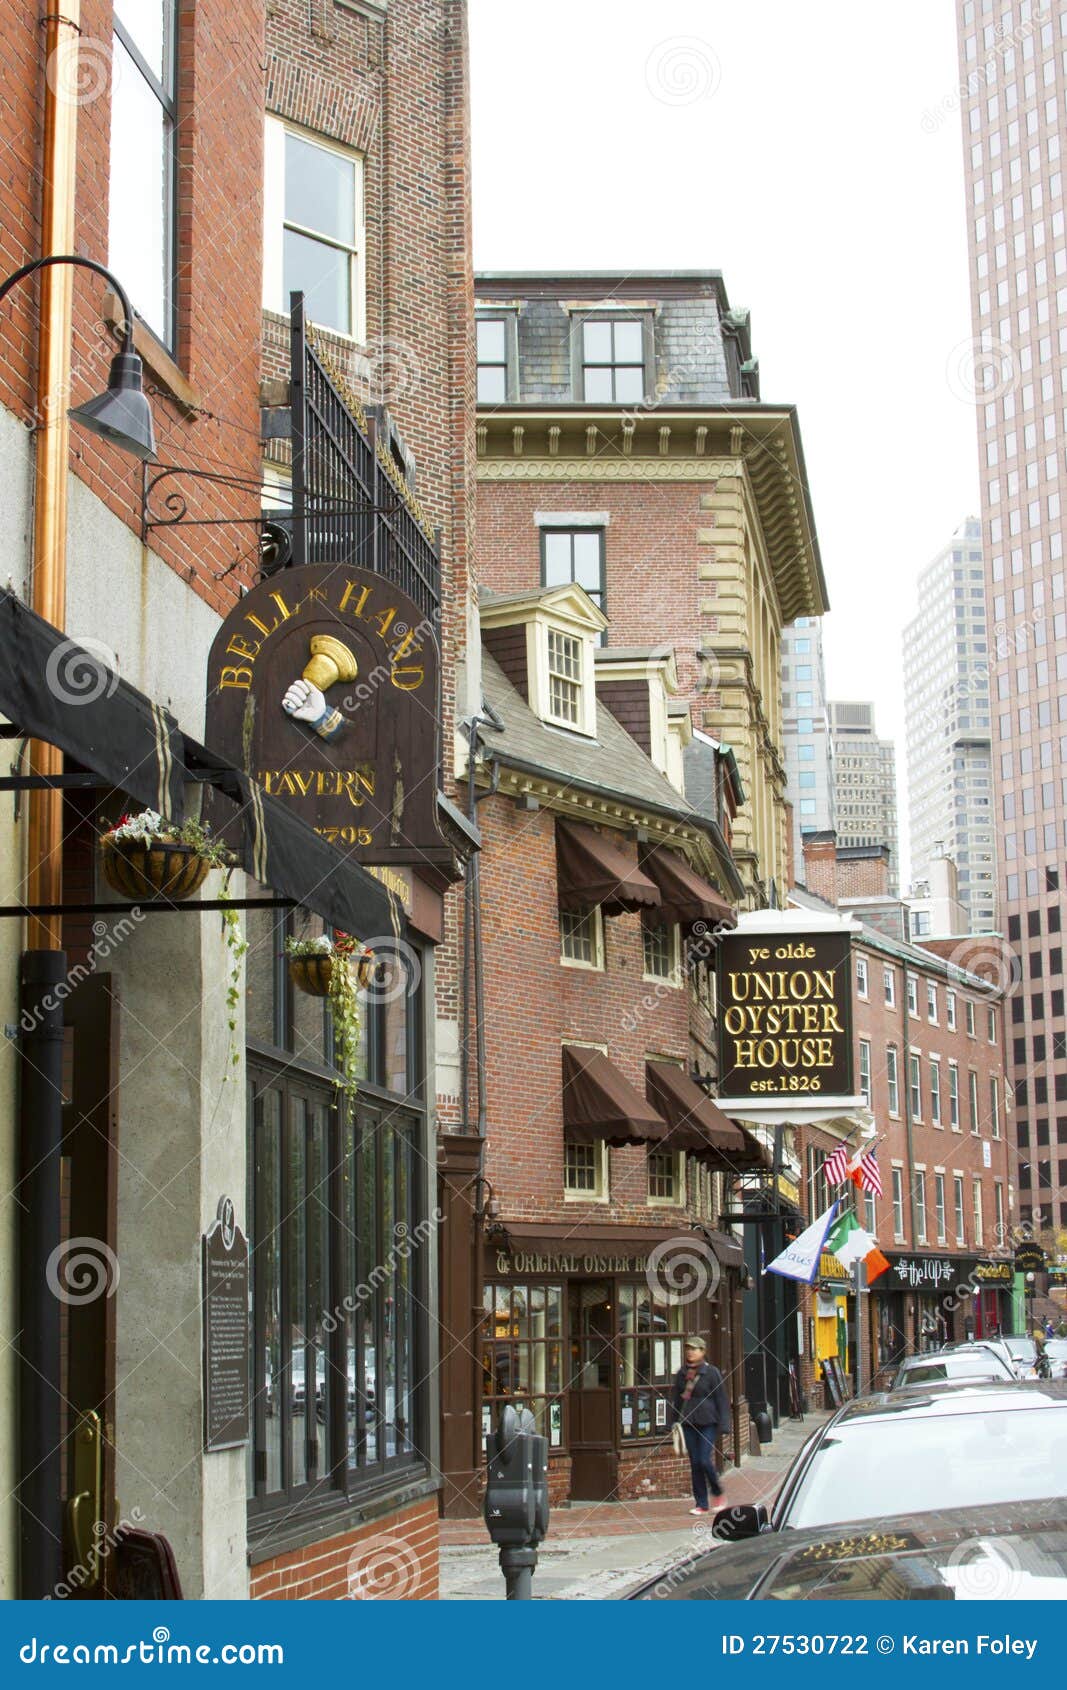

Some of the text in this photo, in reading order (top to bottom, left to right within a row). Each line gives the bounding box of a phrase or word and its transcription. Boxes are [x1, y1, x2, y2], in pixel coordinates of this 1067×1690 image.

[219, 579, 424, 692] BELL IN HAND
[257, 768, 376, 806] TAVERN
[749, 943, 816, 965] ye olde
[728, 970, 837, 1001] UNION
[724, 1003, 844, 1035] OYSTER
[733, 1038, 834, 1068] HOUSE
[750, 1074, 821, 1092] est.1826
[514, 1251, 580, 1273] ORIGINAL
[583, 1253, 630, 1273] OYSTER
